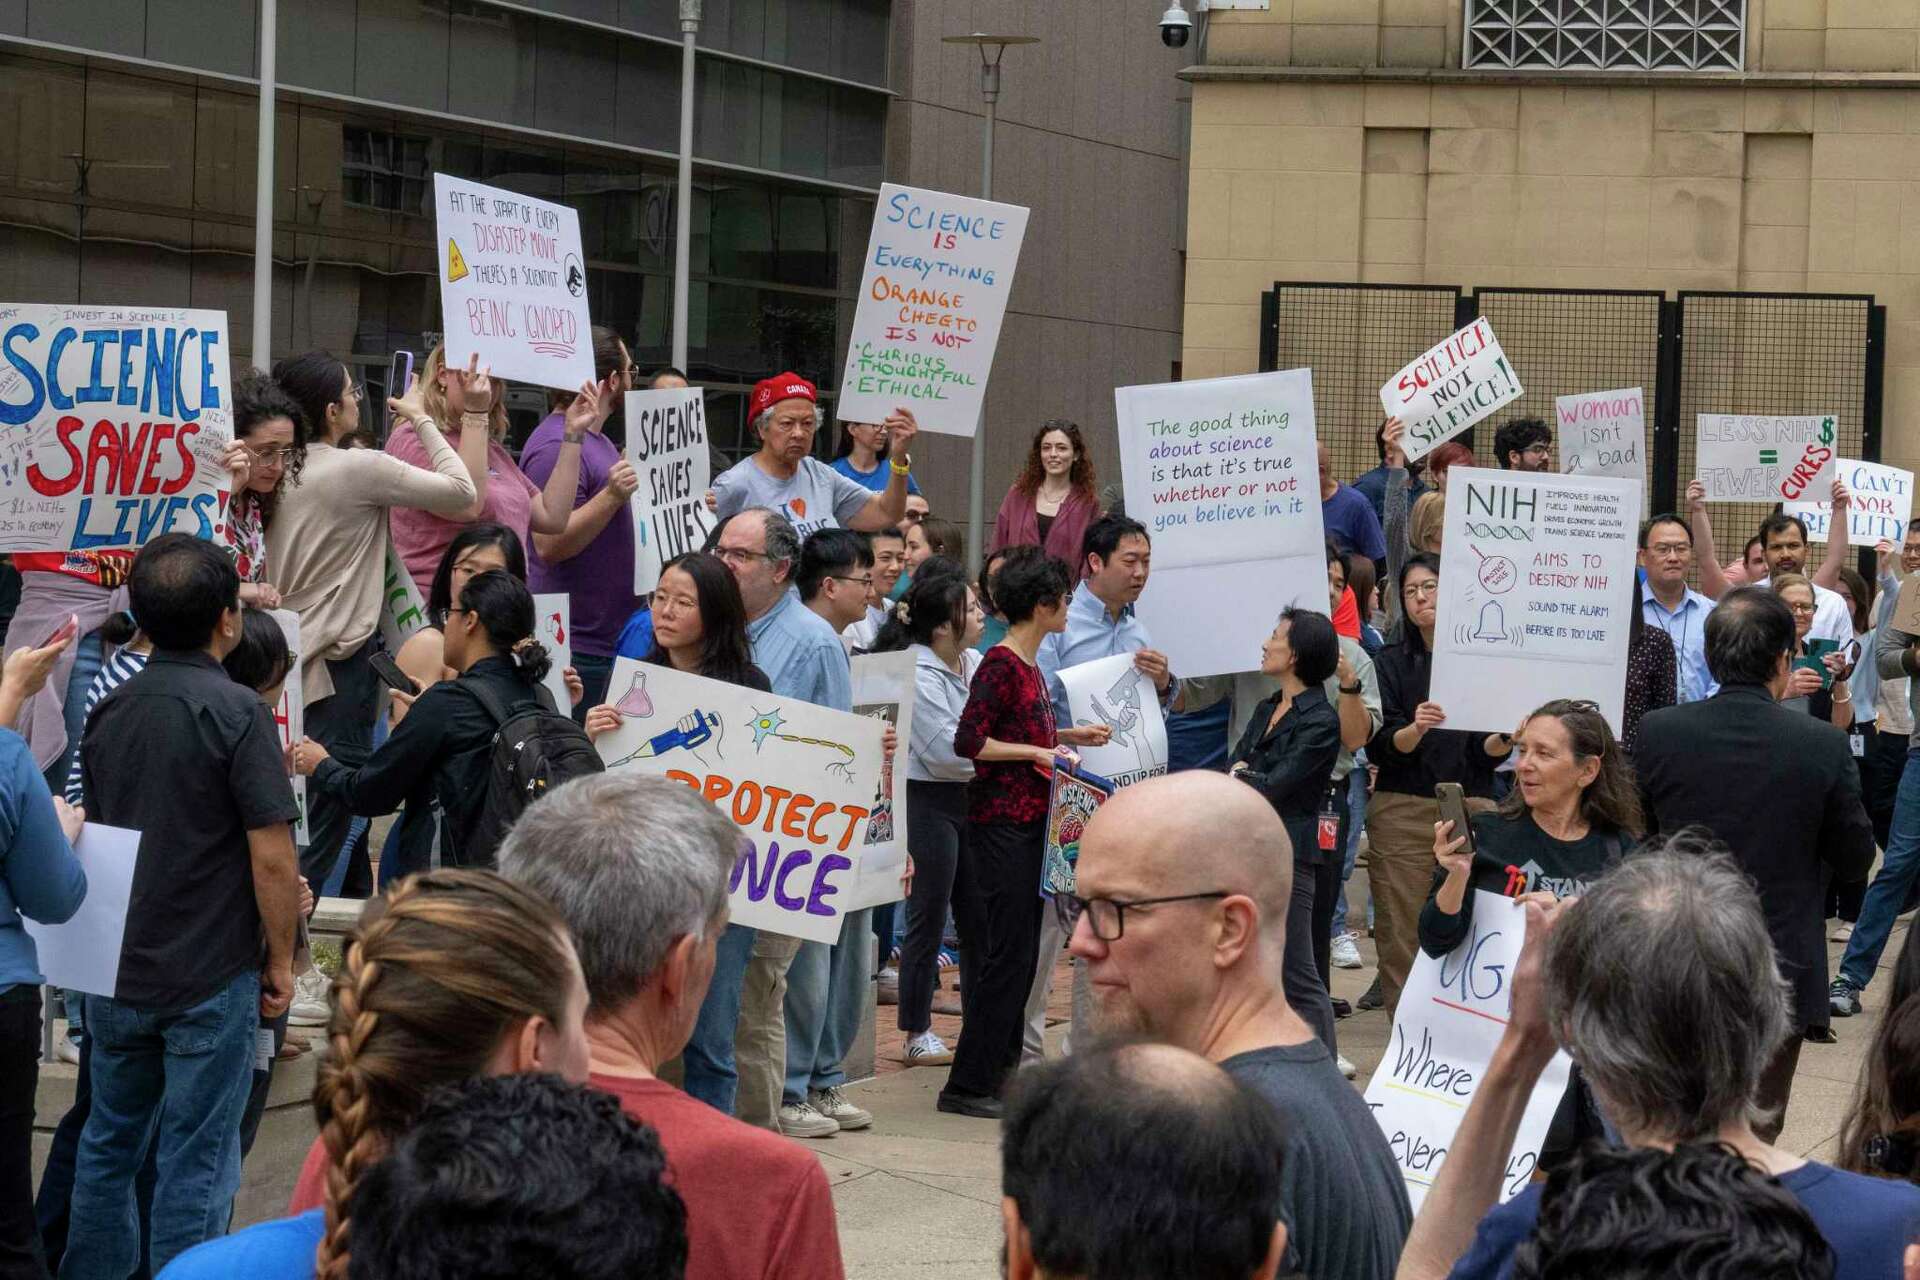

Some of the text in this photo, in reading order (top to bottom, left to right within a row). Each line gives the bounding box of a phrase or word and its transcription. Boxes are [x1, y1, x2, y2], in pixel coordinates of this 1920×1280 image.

[450, 190, 560, 232] AT THE START OF EVERY
[888, 193, 1006, 241] SCIENCE
[473, 222, 560, 264] DISASTER MOVIE
[933, 234, 957, 250] IS
[511, 268, 518, 286] A
[522, 266, 559, 287] SCIENTIST
[875, 245, 995, 286] EVERYTHING
[872, 276, 964, 309] ORANGE
[64, 308, 105, 321] INVEST
[111, 311, 123, 321] IN
[466, 298, 577, 344] BEING IGNORED
[899, 306, 977, 332] CHEETO
[885, 326, 972, 350] IS NOT
[861, 342, 946, 371] CURIOUS
[0, 323, 220, 425] SCIENCE
[858, 359, 976, 387] THOUGHTFUL
[1430, 365, 1474, 409] NOT
[858, 377, 949, 400] ETHICAL
[639, 397, 703, 462] SCIENCE
[1147, 409, 1290, 439] The good thing
[1700, 416, 1770, 442] LESS
[26, 416, 201, 497] SAVES
[1149, 435, 1273, 460] about science
[1597, 440, 1637, 467] bad
[651, 457, 692, 507] SAVES
[1152, 455, 1293, 482] is that it's true
[1781, 444, 1832, 500] CURES
[1153, 476, 1298, 505] whether or not
[1466, 483, 1537, 523] NIH
[1155, 497, 1304, 532] you believe in it
[1573, 504, 1618, 514] INNOVATION
[1797, 511, 1908, 543] RELITY
[1532, 552, 1603, 569] AIMS TO
[1528, 572, 1608, 590] DESTROY NIH
[1528, 601, 1609, 617] SOUND THE ALARM
[1525, 624, 1555, 637] BEFORE
[1570, 628, 1586, 639] TOO
[1587, 630, 1607, 641] LATE
[1393, 1023, 1473, 1097] Where
